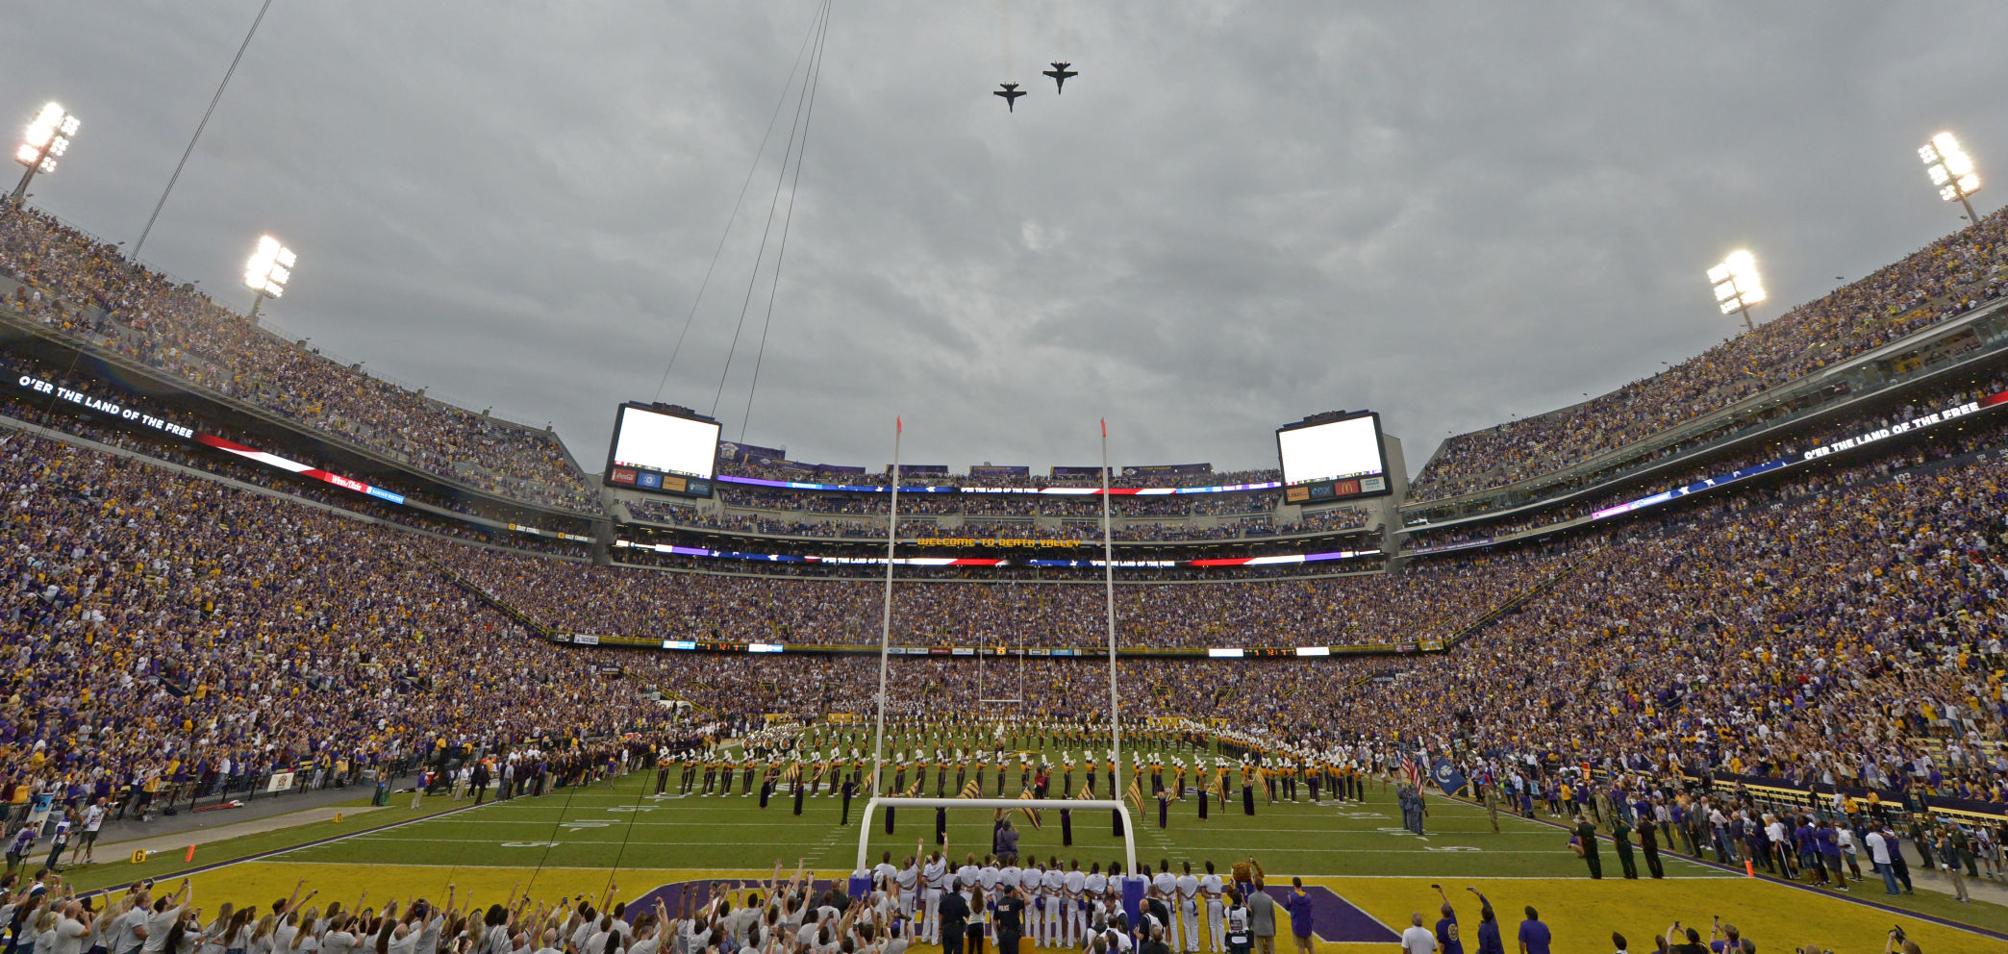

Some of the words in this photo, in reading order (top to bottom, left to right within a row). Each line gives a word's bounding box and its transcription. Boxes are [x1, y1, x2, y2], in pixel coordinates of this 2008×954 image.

[18, 375, 53, 394] O'ER
[57, 386, 84, 404] THE
[85, 396, 120, 415] LAND
[122, 408, 140, 421] OF
[142, 414, 164, 430] THE
[164, 422, 194, 439] FREE
[1803, 446, 1829, 460] O'ER
[1831, 438, 1855, 452] THE
[1856, 429, 1890, 445] LAND
[1892, 422, 1911, 435] OF
[1912, 413, 1940, 428] THE
[1942, 402, 1980, 420] FREE
[917, 537, 976, 547] WELCOME
[981, 538, 995, 547] TO
[999, 538, 1035, 548] DEATH
[1040, 538, 1081, 547] VALLEY
[135, 850, 143, 862] G
[998, 904, 1010, 912] POLICE
